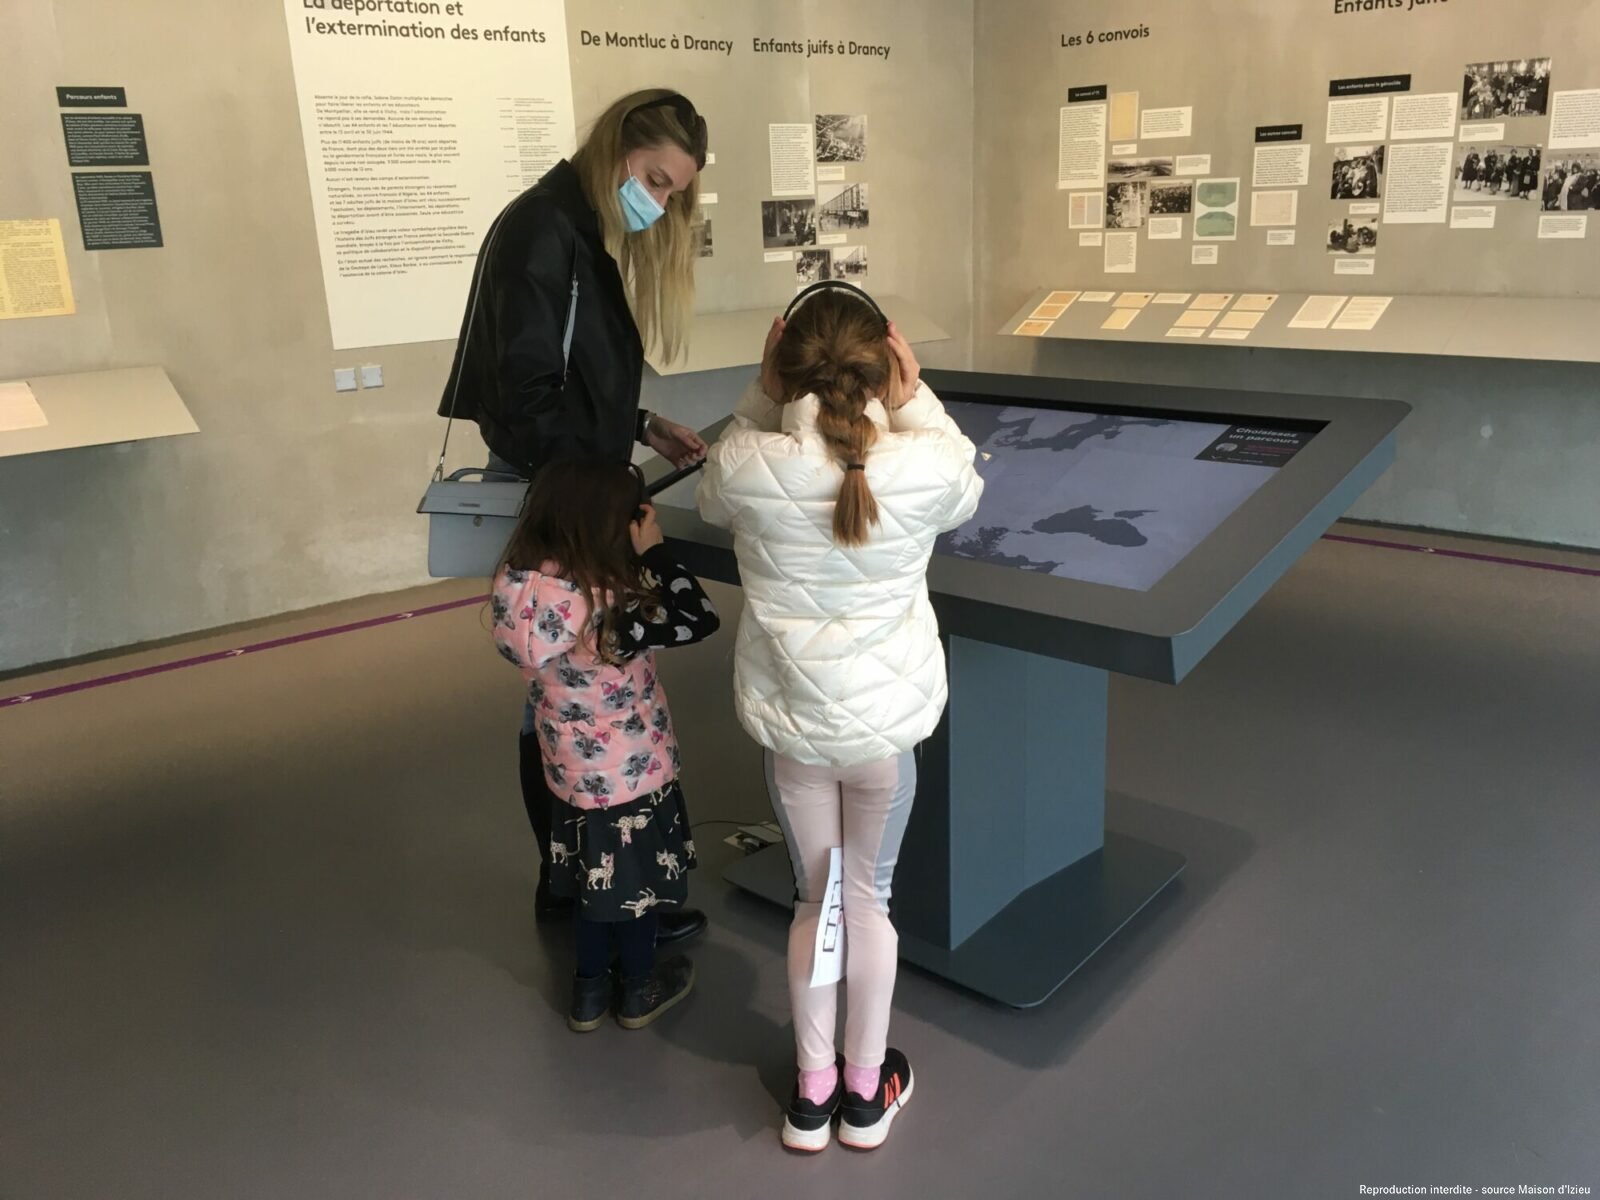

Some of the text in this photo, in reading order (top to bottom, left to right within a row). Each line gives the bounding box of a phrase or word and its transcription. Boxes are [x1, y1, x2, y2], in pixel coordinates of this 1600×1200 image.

[445, 1, 464, 16] et
[306, 16, 546, 43] l'extermination des enfants
[1061, 23, 1150, 48] Les 6 convois
[580, 30, 733, 56] De Montluc à Drancy
[753, 37, 890, 60] Enfants juifs à Drancy
[1236, 427, 1297, 438] Choisissez
[1245, 435, 1299, 445] parcours
